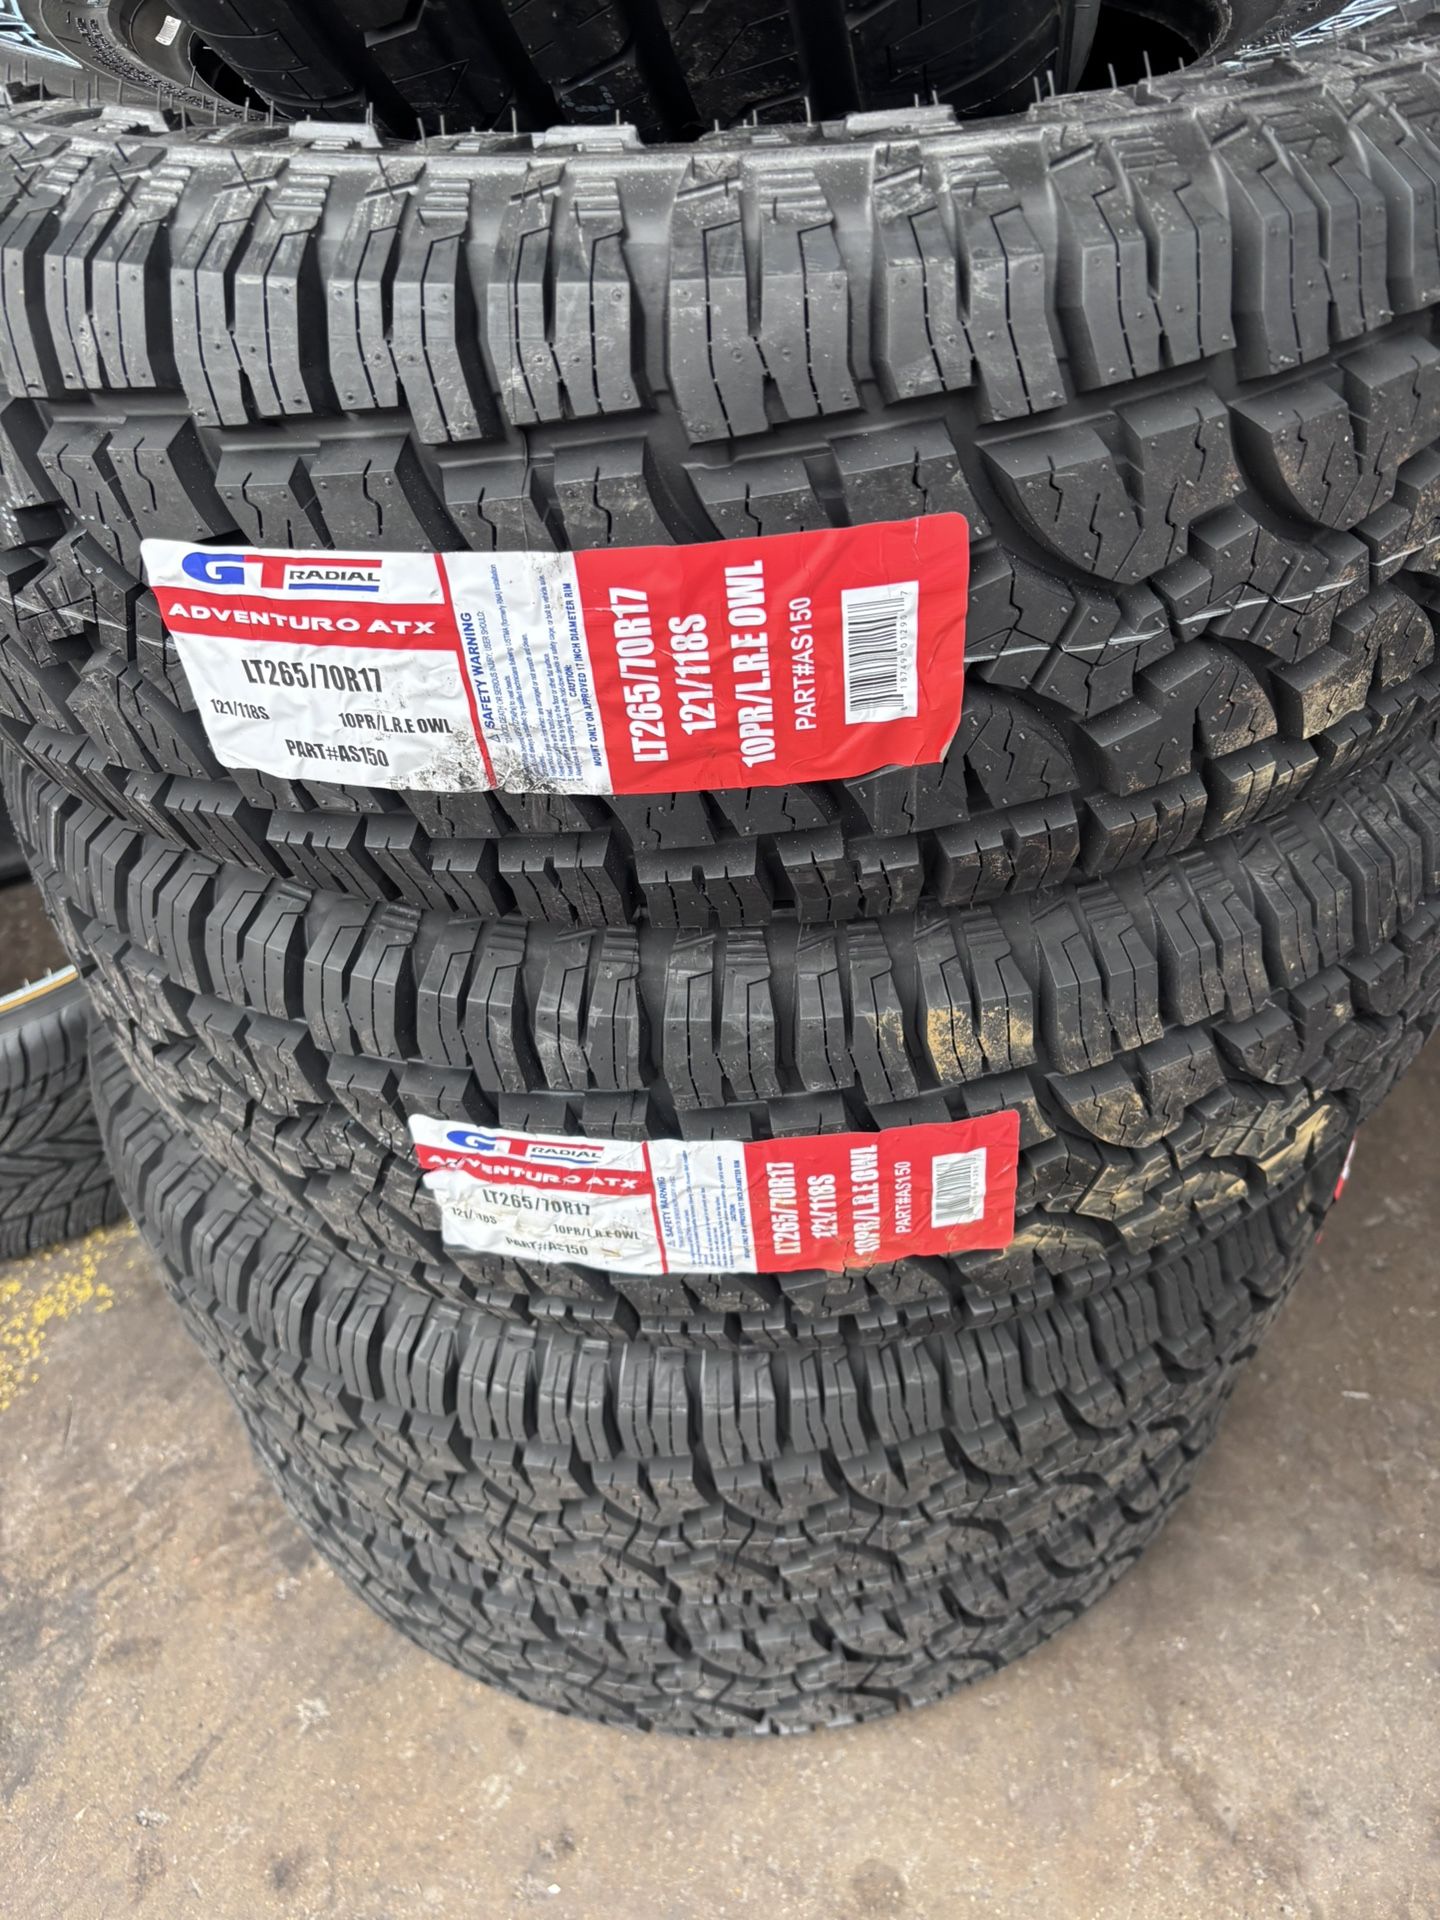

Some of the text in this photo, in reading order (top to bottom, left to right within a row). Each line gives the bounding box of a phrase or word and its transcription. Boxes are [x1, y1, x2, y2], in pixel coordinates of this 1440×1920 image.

[182, 551, 381, 590] GT RADIAL
[168, 602, 435, 635] ADVENTURO ATX
[241, 659, 383, 692] LT265/70R17
[460, 612, 495, 729] SAFETY WARNING
[562, 583, 601, 766] MOUNT ONLY ON APPROVED 17 INCH DIAMETER RIM
[564, 664, 576, 697] CAUTION:
[608, 586, 669, 763] LT265/70R17
[667, 613, 717, 736] 121/118S
[724, 559, 777, 768] 10PR/L.R.E OWL
[788, 597, 817, 732] PART#AS150
[210, 699, 270, 720] 121/118S
[338, 712, 453, 734] 10PR/L.R.E OWL
[285, 739, 389, 767] PART#AS150
[446, 1130, 601, 1159] GT RADIAL
[850, 1143, 878, 1182] OWL
[586, 1176, 639, 1189] ATX
[893, 1160, 911, 1234] PART#AS150
[482, 1189, 591, 1217] LT265/70R17
[656, 1176, 673, 1236] SAFETY WARNING
[766, 1161, 801, 1256] LT265/70R17
[807, 1172, 839, 1240] 121/118S
[614, 1231, 641, 1241] OWL
